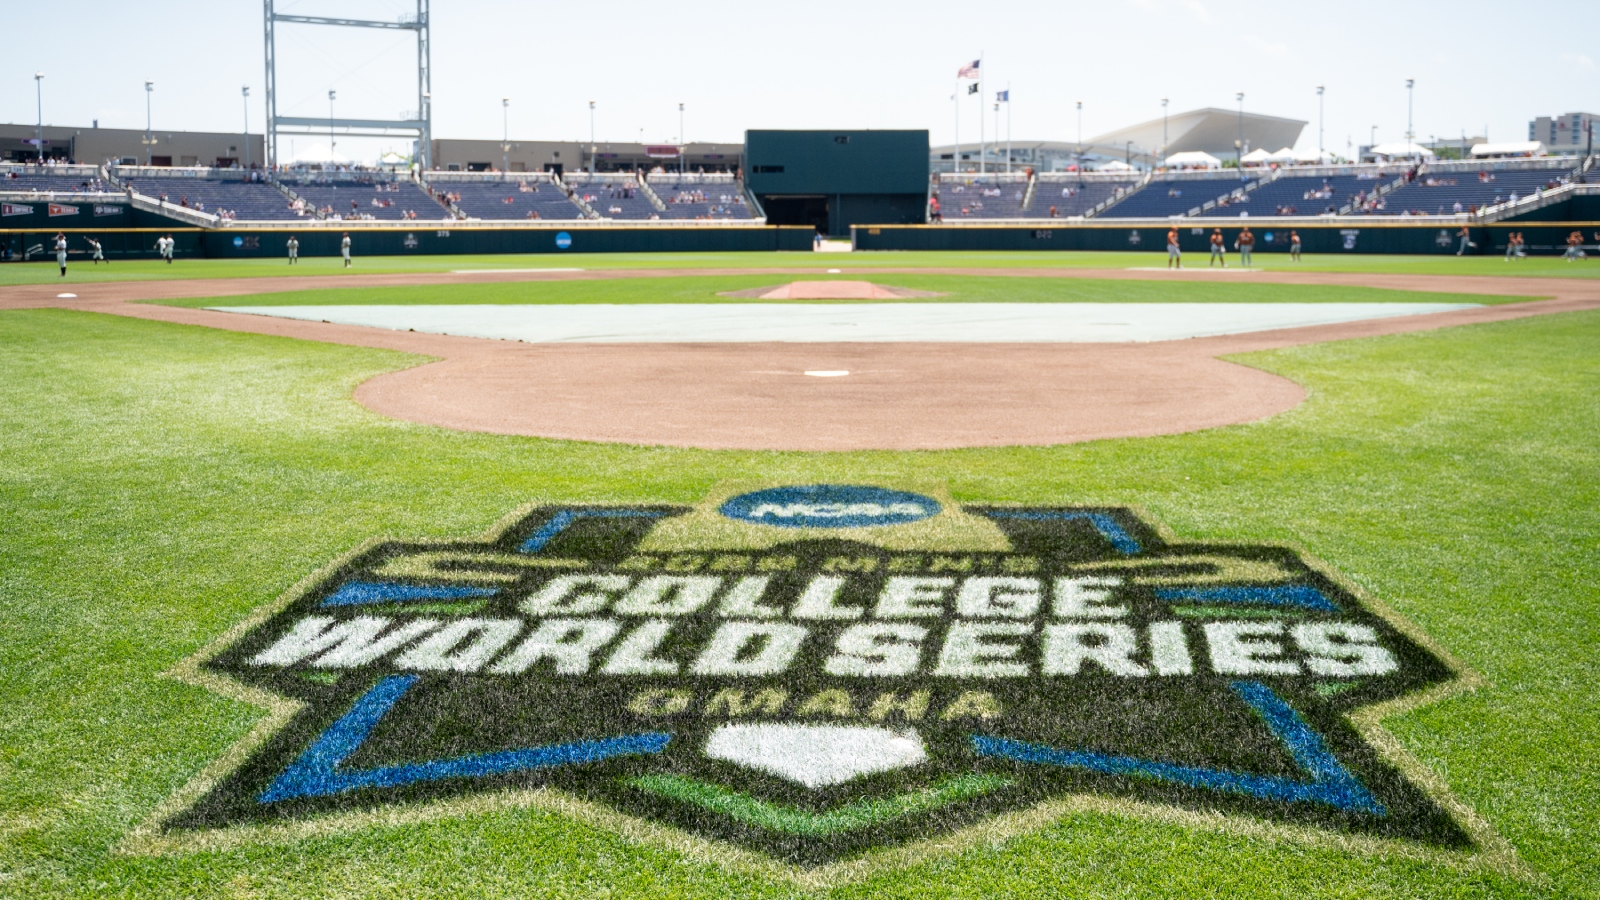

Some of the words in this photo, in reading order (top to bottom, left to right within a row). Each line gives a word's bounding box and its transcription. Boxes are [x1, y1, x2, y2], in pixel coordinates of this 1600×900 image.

[748, 501, 926, 519] NCAA
[518, 573, 1130, 621] COLLEGE
[247, 613, 808, 679] WORLD
[822, 618, 1400, 679] SERIES
[627, 687, 1002, 721] OMAHA
